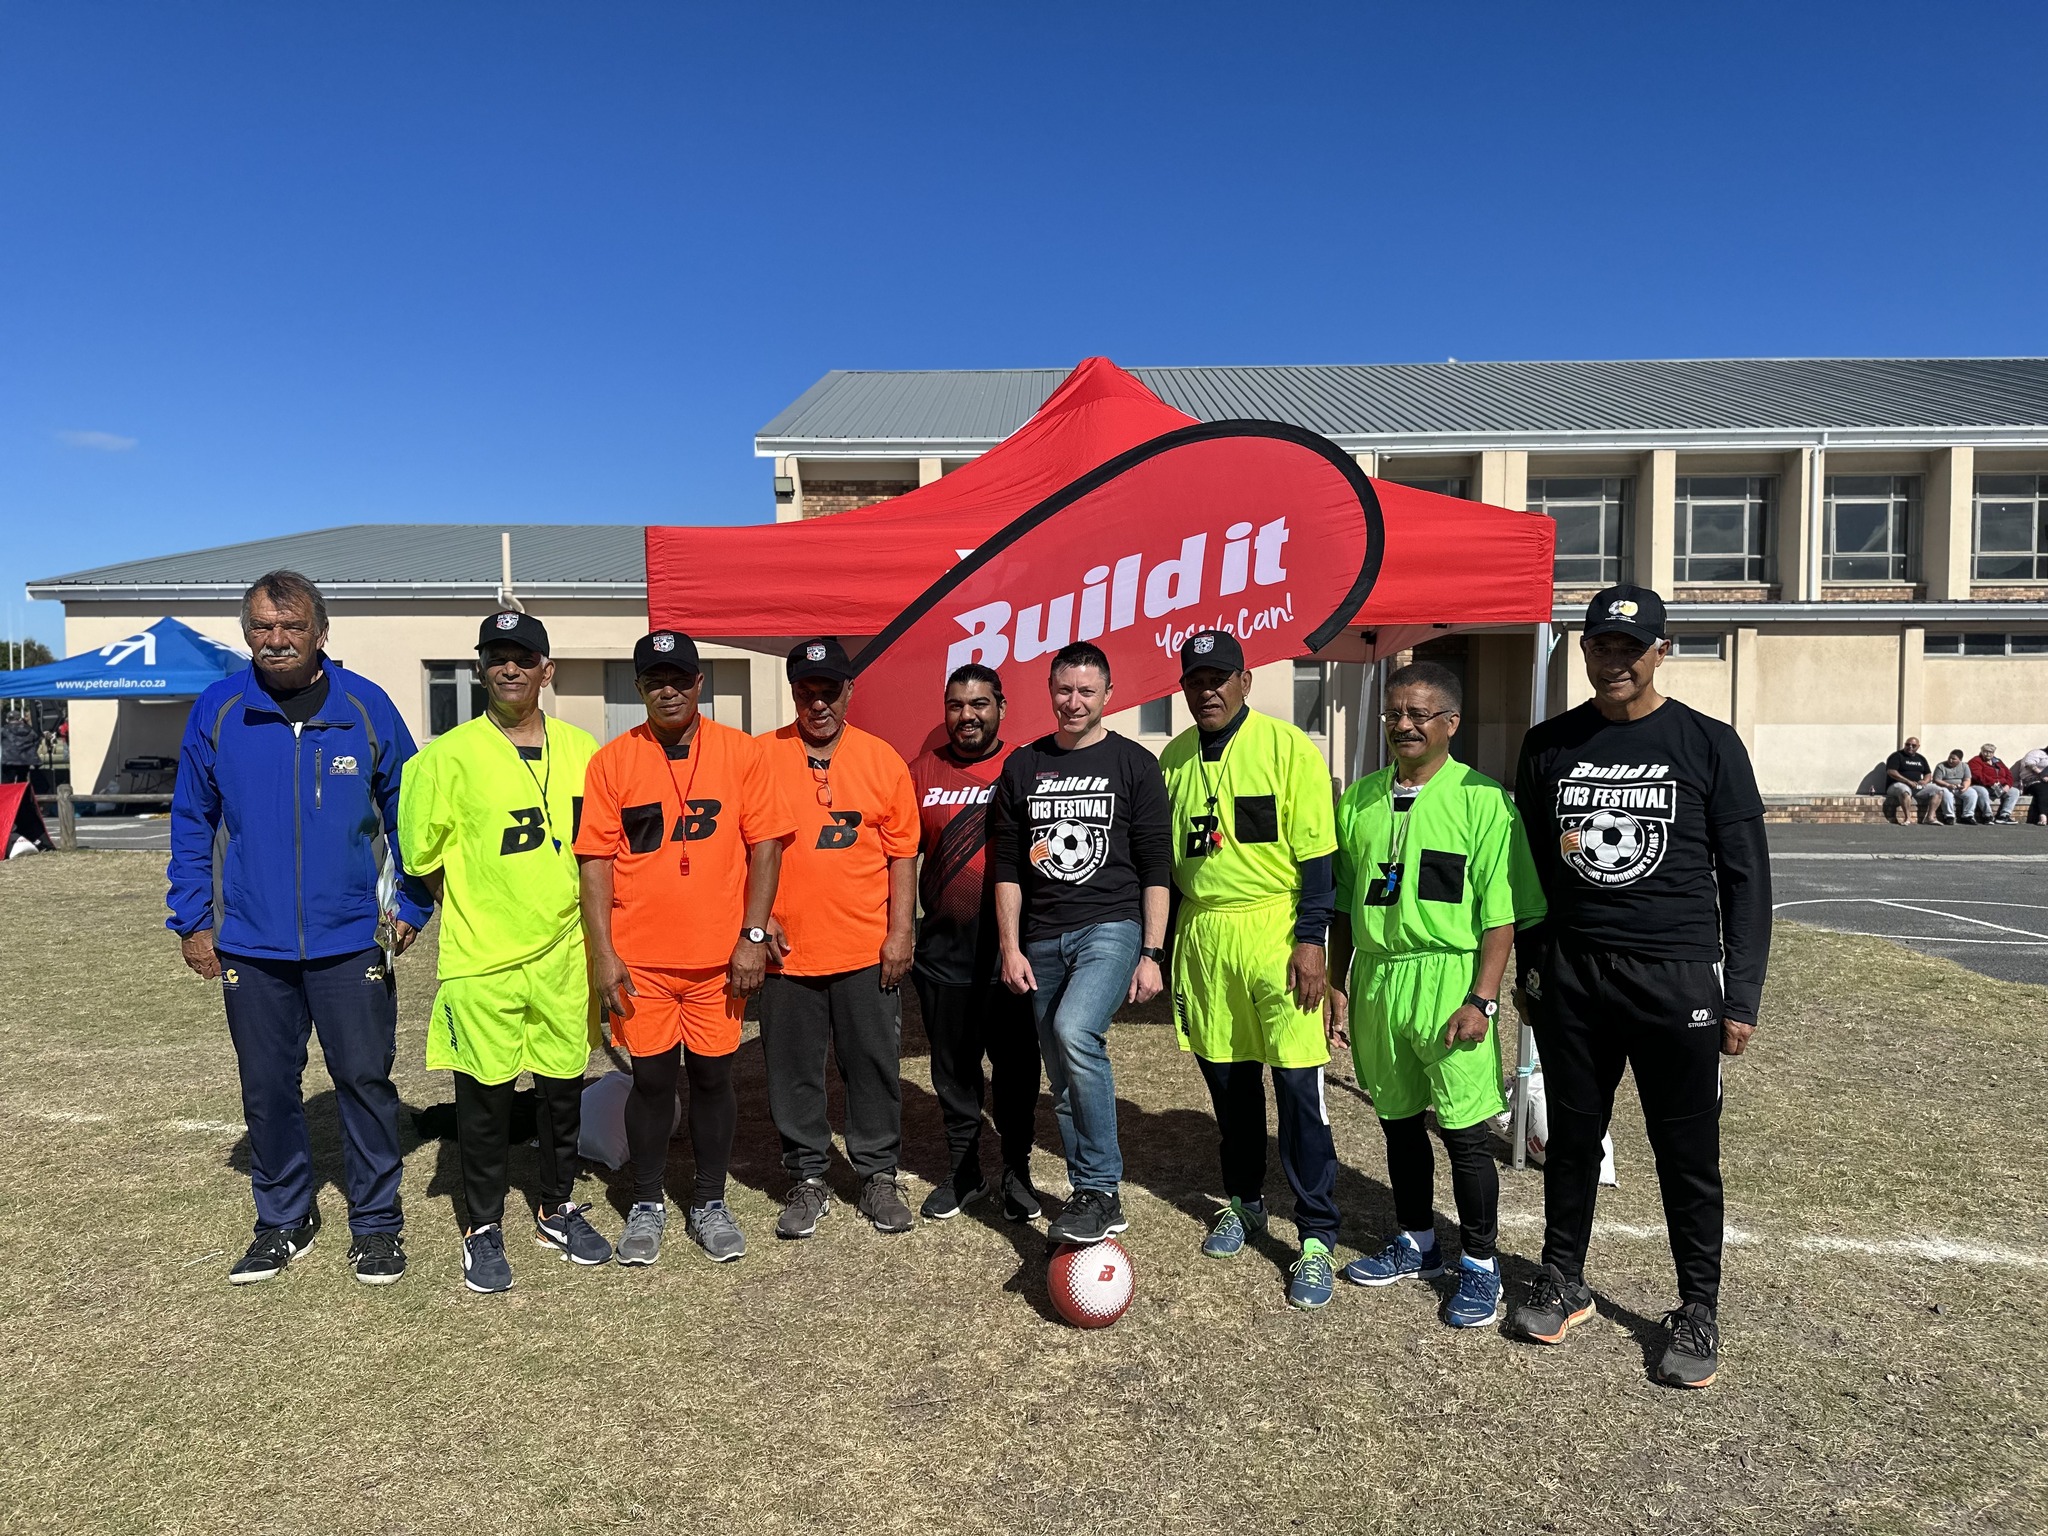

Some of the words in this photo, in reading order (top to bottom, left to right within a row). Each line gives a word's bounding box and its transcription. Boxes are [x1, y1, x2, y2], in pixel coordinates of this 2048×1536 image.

[945, 532, 1207, 690] Build
[1220, 516, 1290, 597] it
[1238, 592, 1295, 640] Can!
[56, 678, 166, 691] www.peterallan.co.za
[1569, 762, 1647, 779] Build
[1643, 764, 1670, 779] it
[922, 785, 998, 808] Build
[1036, 776, 1093, 794] Build
[1089, 777, 1109, 792] it
[1032, 801, 1051, 819] U13
[1054, 799, 1109, 818] FESTIVAL
[1563, 786, 1590, 806] U13
[1592, 787, 1669, 809] FESTIVAL
[500, 806, 545, 856] B
[670, 799, 722, 841] B
[815, 810, 863, 850] B
[1602, 857, 1652, 883] TOMORROW'S
[1648, 832, 1660, 859] STARS
[1097, 1264, 1116, 1282] B
